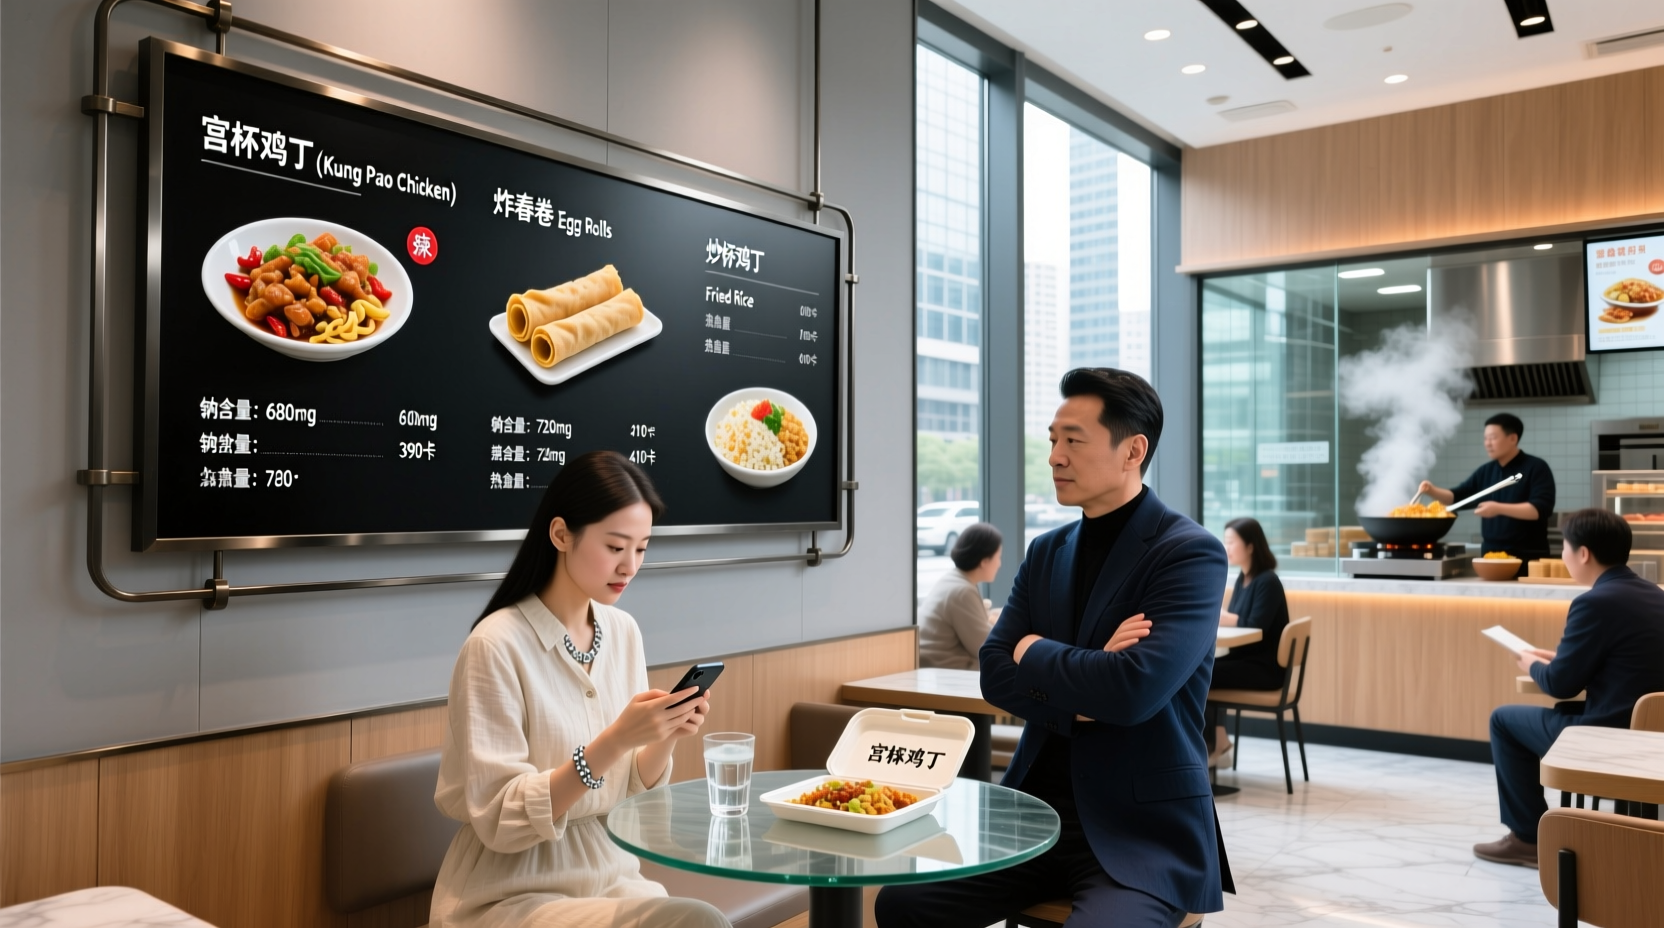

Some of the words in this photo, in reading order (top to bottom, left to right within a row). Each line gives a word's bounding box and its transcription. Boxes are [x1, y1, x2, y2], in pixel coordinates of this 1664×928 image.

[316, 149, 362, 187] (Kung
[366, 165, 393, 188] Pao
[396, 172, 457, 207] Chicken)
[493, 187, 554, 227] 炸春卷
[558, 210, 582, 237] Egg
[585, 217, 613, 239] Rolls
[705, 286, 732, 304] Fried
[734, 290, 755, 308] Rice
[265, 402, 317, 427] 680mg
[536, 418, 572, 439] 720mg
[399, 440, 436, 461] 390卡
